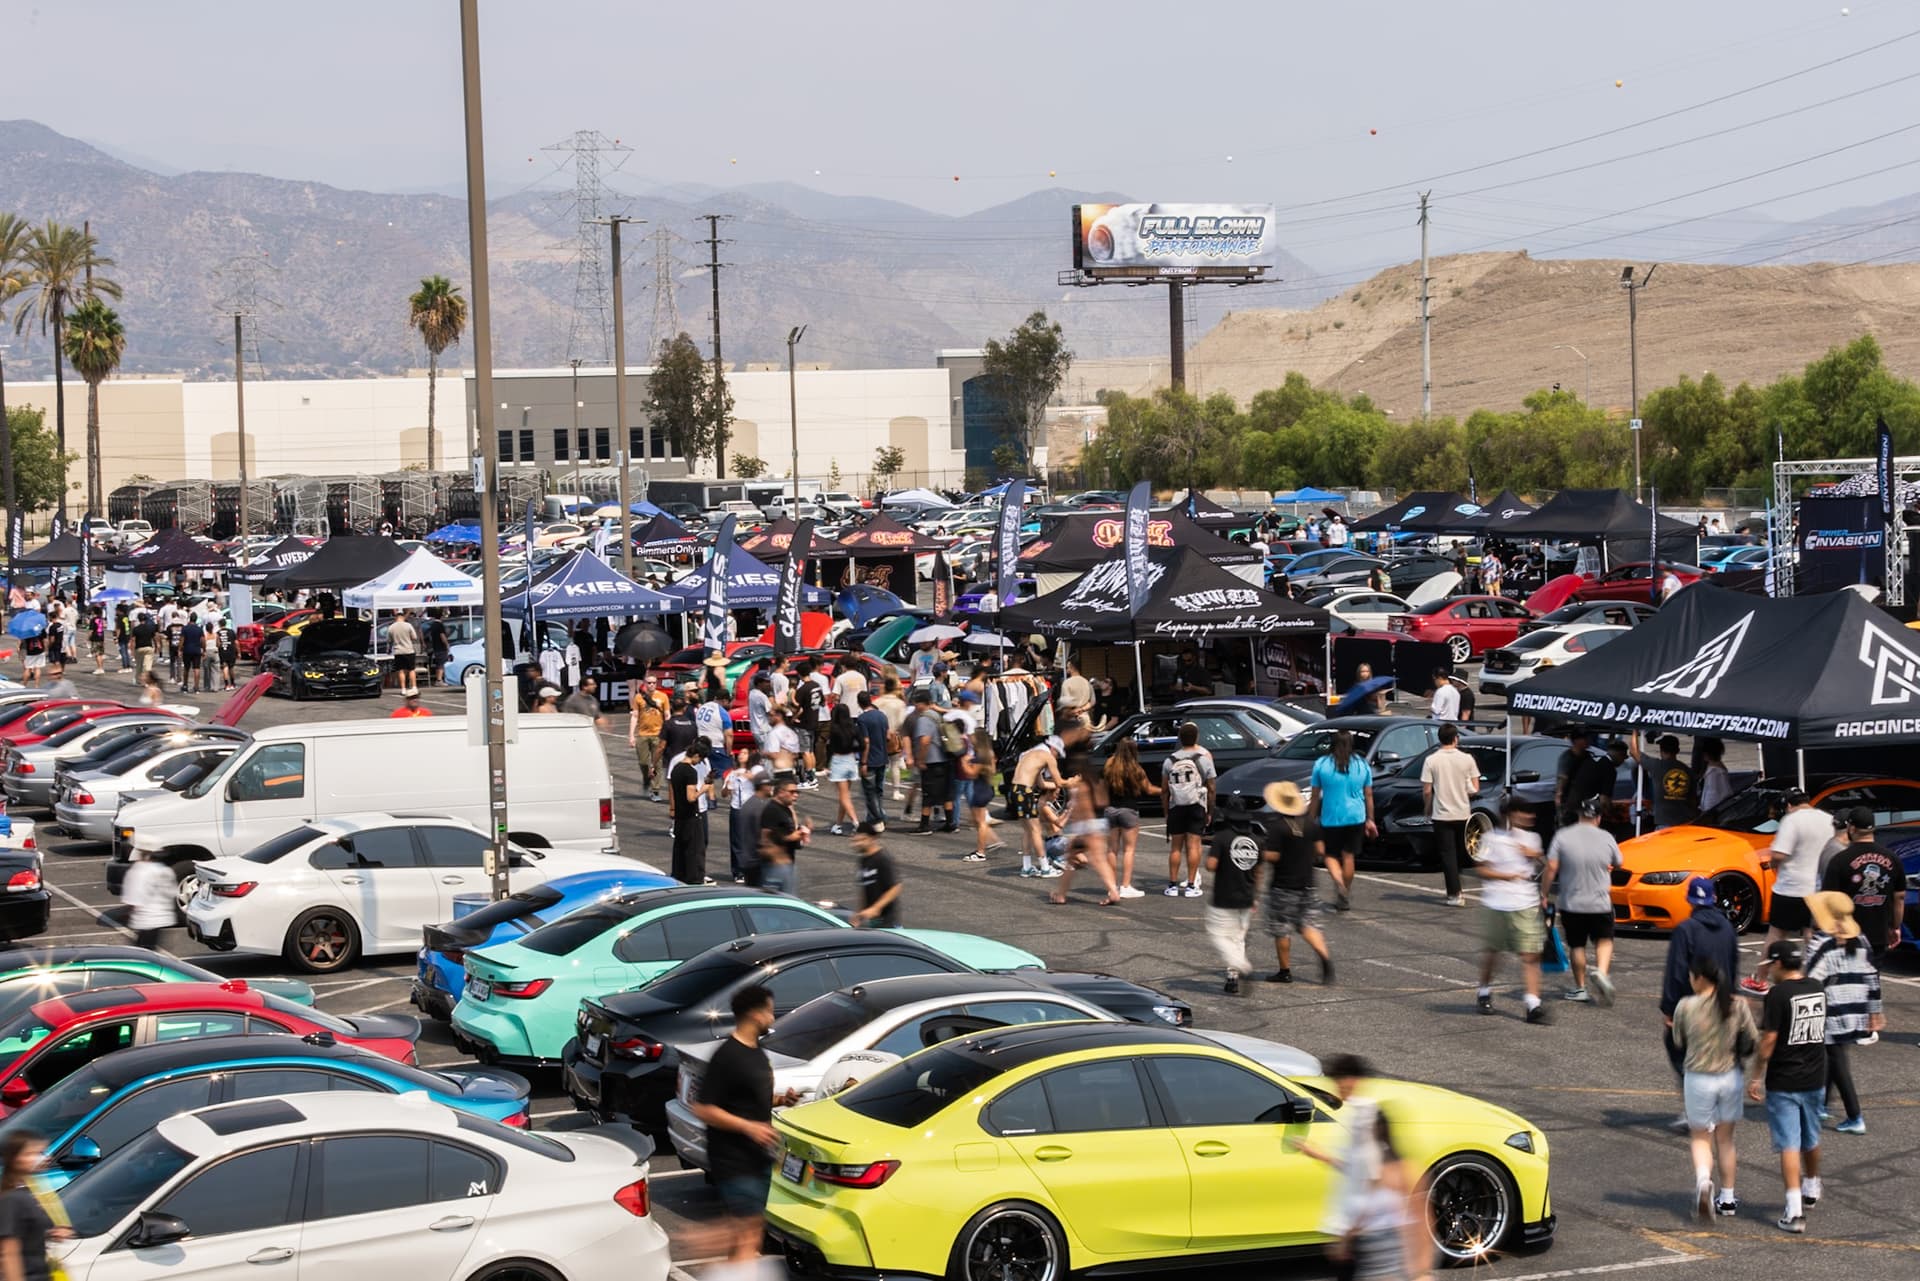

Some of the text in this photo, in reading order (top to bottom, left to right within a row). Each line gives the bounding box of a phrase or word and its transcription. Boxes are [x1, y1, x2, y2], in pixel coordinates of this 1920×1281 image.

[1143, 218, 1264, 237] FULL BLOWN
[1149, 238, 1259, 256] PERFORMANCE
[1815, 535, 1880, 547] INVASION
[564, 580, 633, 597] KIES
[705, 552, 726, 650] KIES
[1155, 615, 1316, 637] Keeping up with the Bavarians
[697, 707, 714, 722] 86
